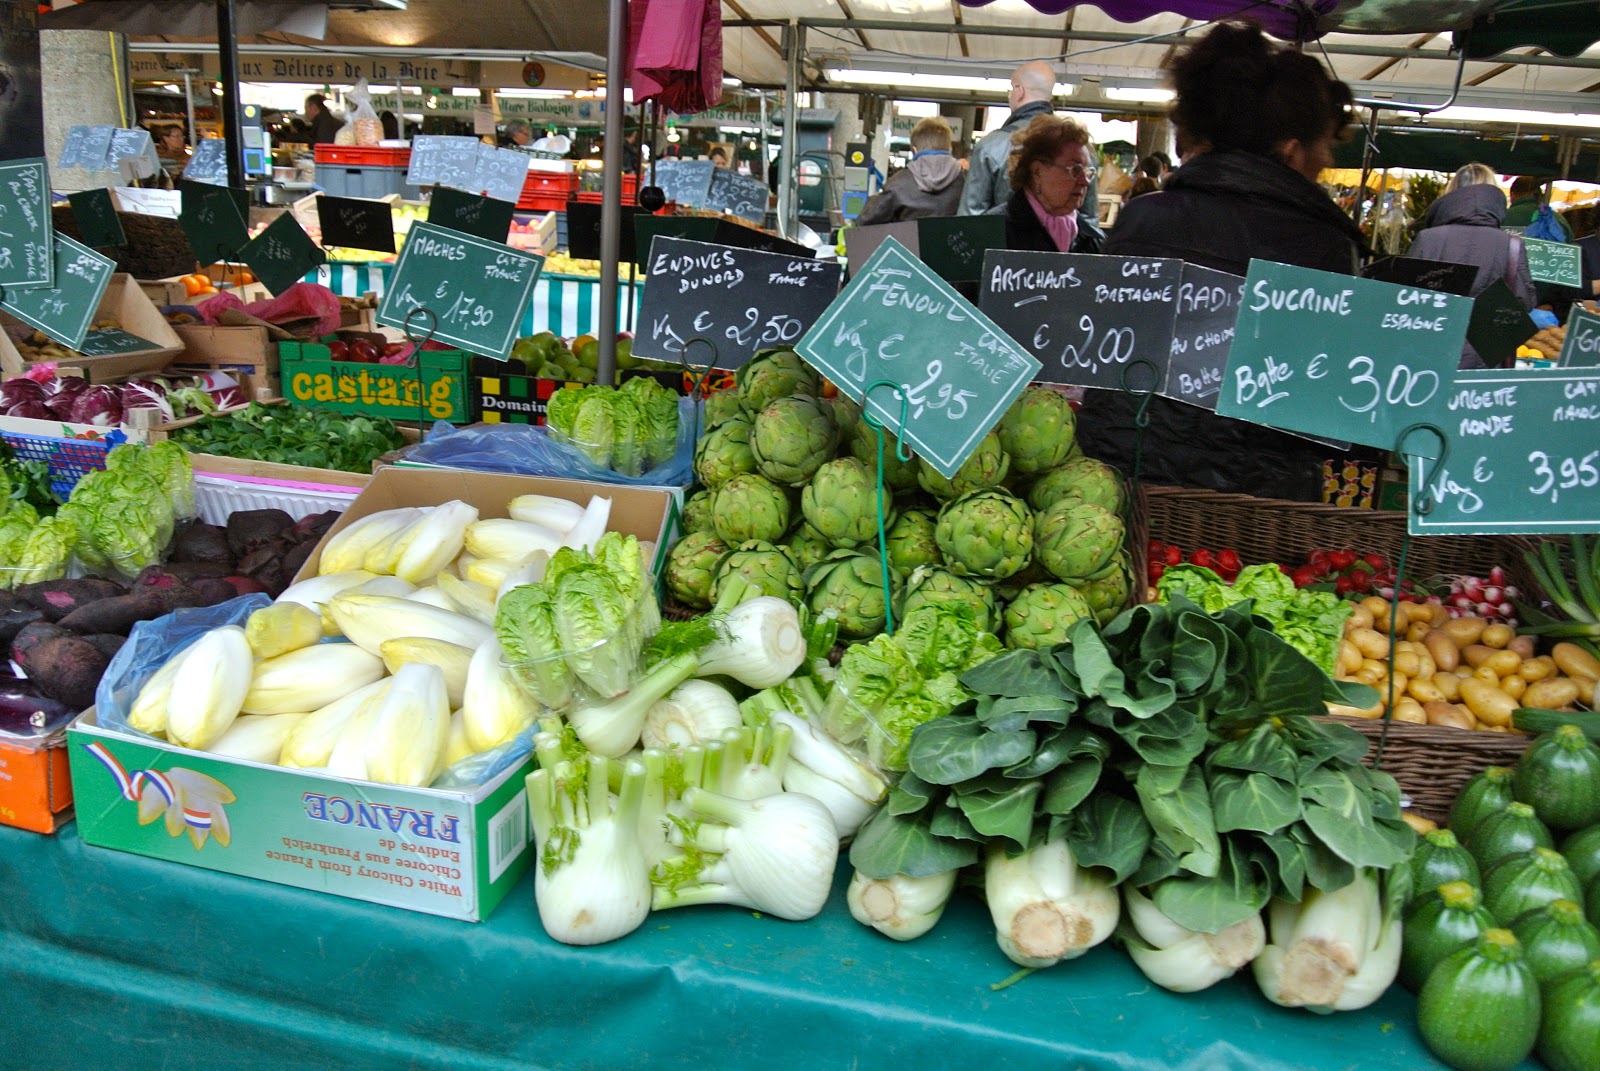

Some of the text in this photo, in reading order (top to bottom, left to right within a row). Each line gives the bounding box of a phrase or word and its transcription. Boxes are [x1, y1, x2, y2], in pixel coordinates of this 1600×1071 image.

[240, 58, 438, 80] ux Délices de la Brie
[413, 236, 467, 261] MACHES
[652, 250, 736, 276] ENDIVES
[484, 265, 522, 282] FRANCE
[768, 272, 809, 287] FRANCE
[990, 264, 1082, 293] ARTICHAUTS
[441, 290, 494, 331] 17,90
[863, 267, 966, 322] FENOUIL
[1094, 284, 1173, 305] BRETAGNE
[1249, 279, 1354, 315] SUCRINE
[725, 307, 803, 352] 2,50
[1170, 326, 1235, 355] AU CHOIX
[1380, 313, 1449, 332] ESPAGNE
[1060, 314, 1135, 375] 2,00
[954, 341, 1009, 385] ITALIE
[292, 369, 454, 419] castang
[892, 359, 978, 420] 2,95
[1306, 353, 1329, 379] €
[1338, 355, 1440, 423] 3,00
[1447, 385, 1518, 411] URGETTE
[1459, 415, 1514, 437] RONDE
[1528, 450, 1600, 504] 3,95
[302, 792, 461, 844] FRANCE
[282, 837, 461, 880] Chicoree aus Frankreich
[379, 838, 461, 863] Endives de
[266, 850, 463, 897] White Chicory from France
